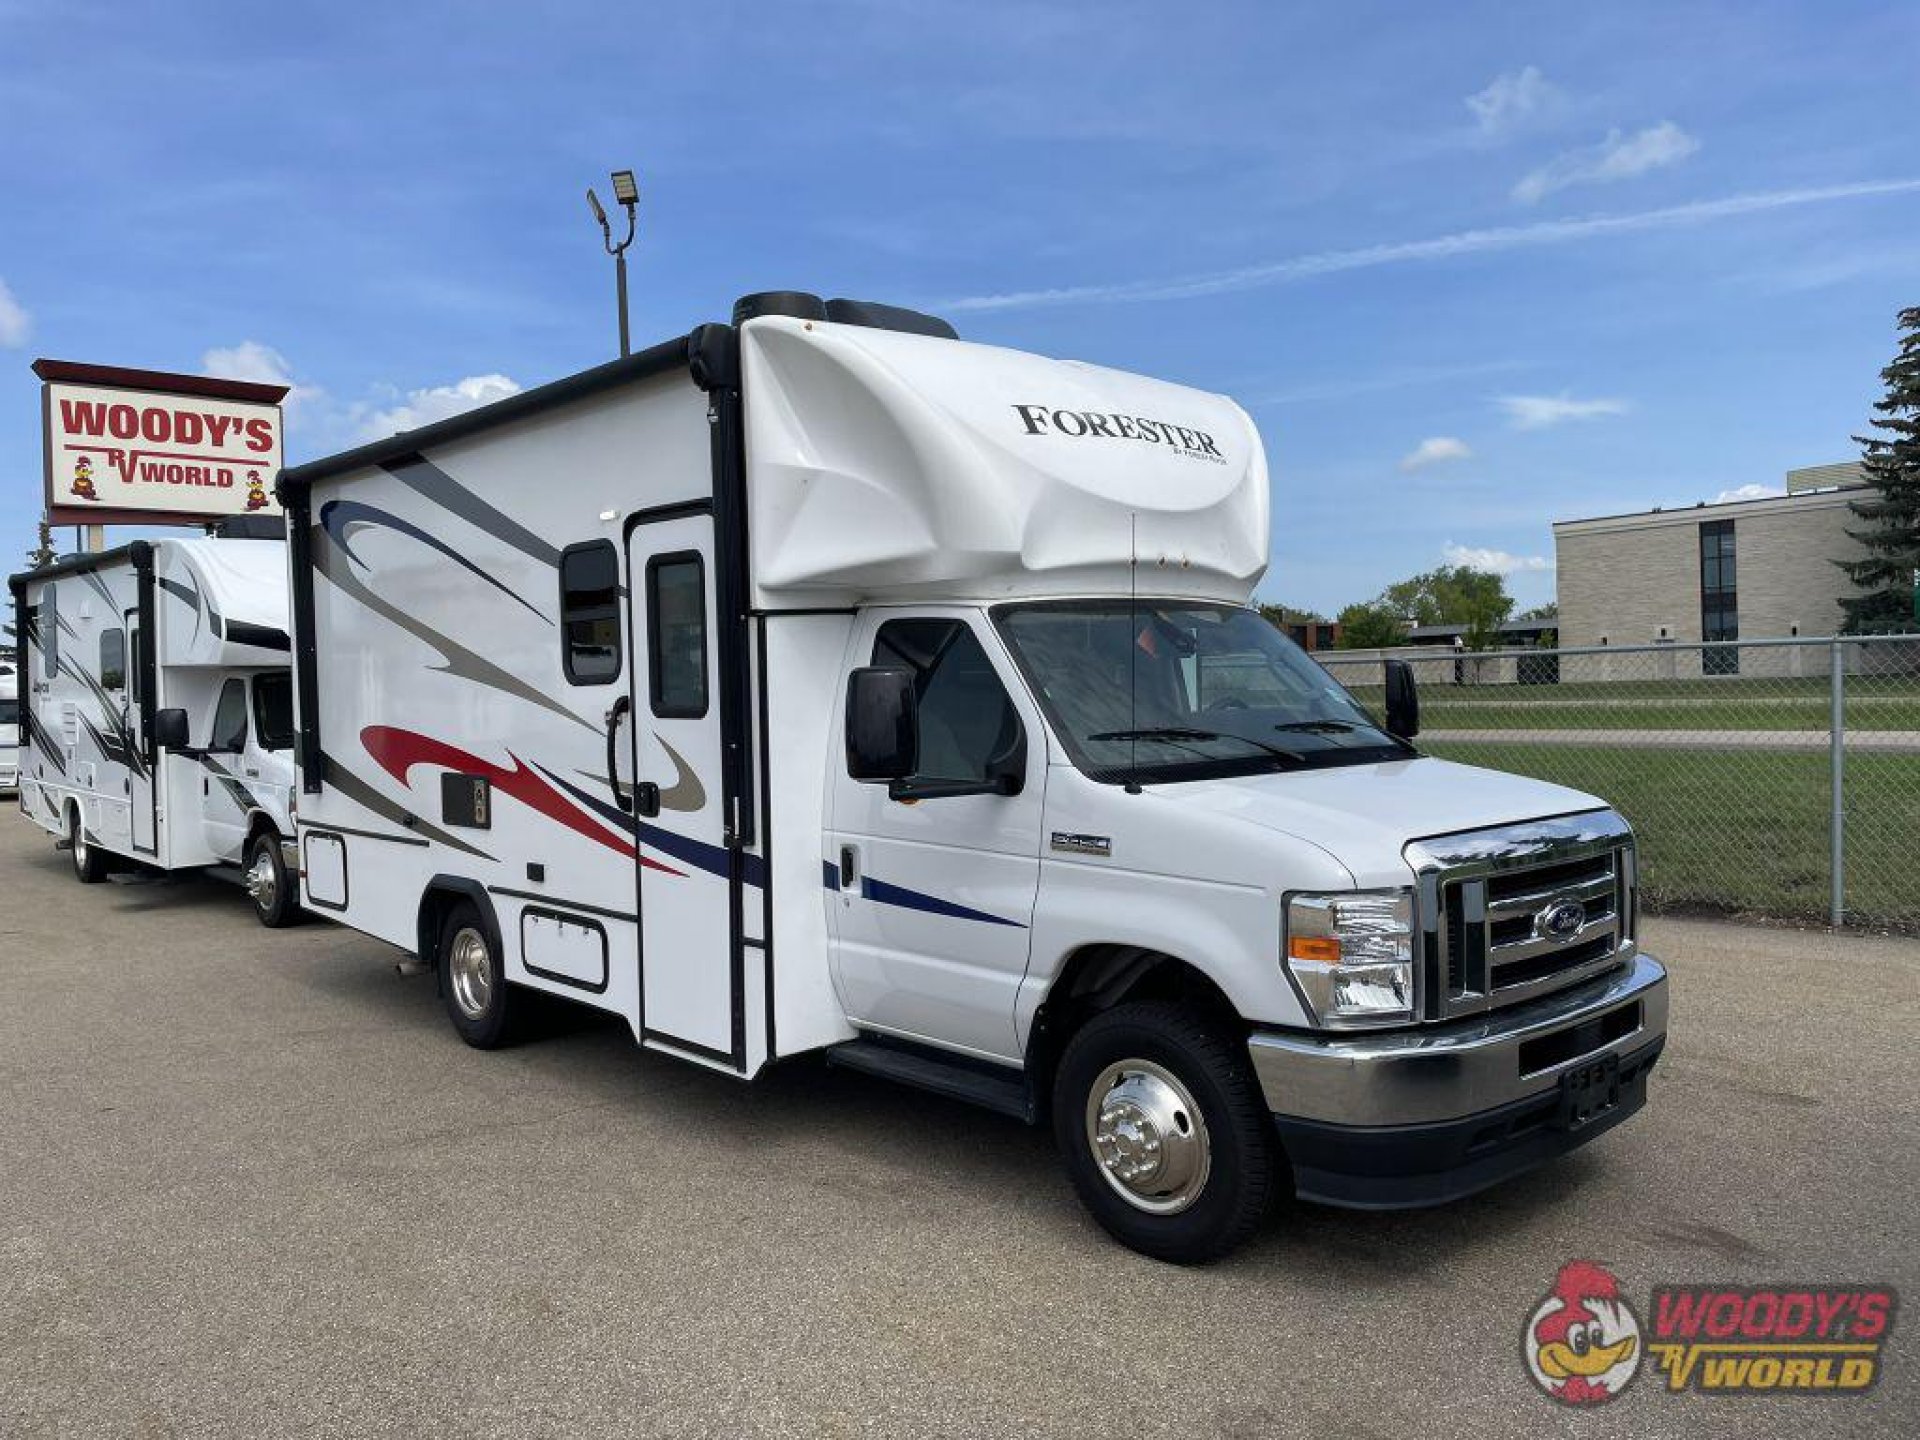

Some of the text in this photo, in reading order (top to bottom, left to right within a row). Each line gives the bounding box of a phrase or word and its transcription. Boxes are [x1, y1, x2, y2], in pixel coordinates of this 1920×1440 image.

[60, 399, 273, 452] WOODY'S
[1011, 404, 1222, 457] FORESTER
[108, 450, 234, 488] RV WORLD
